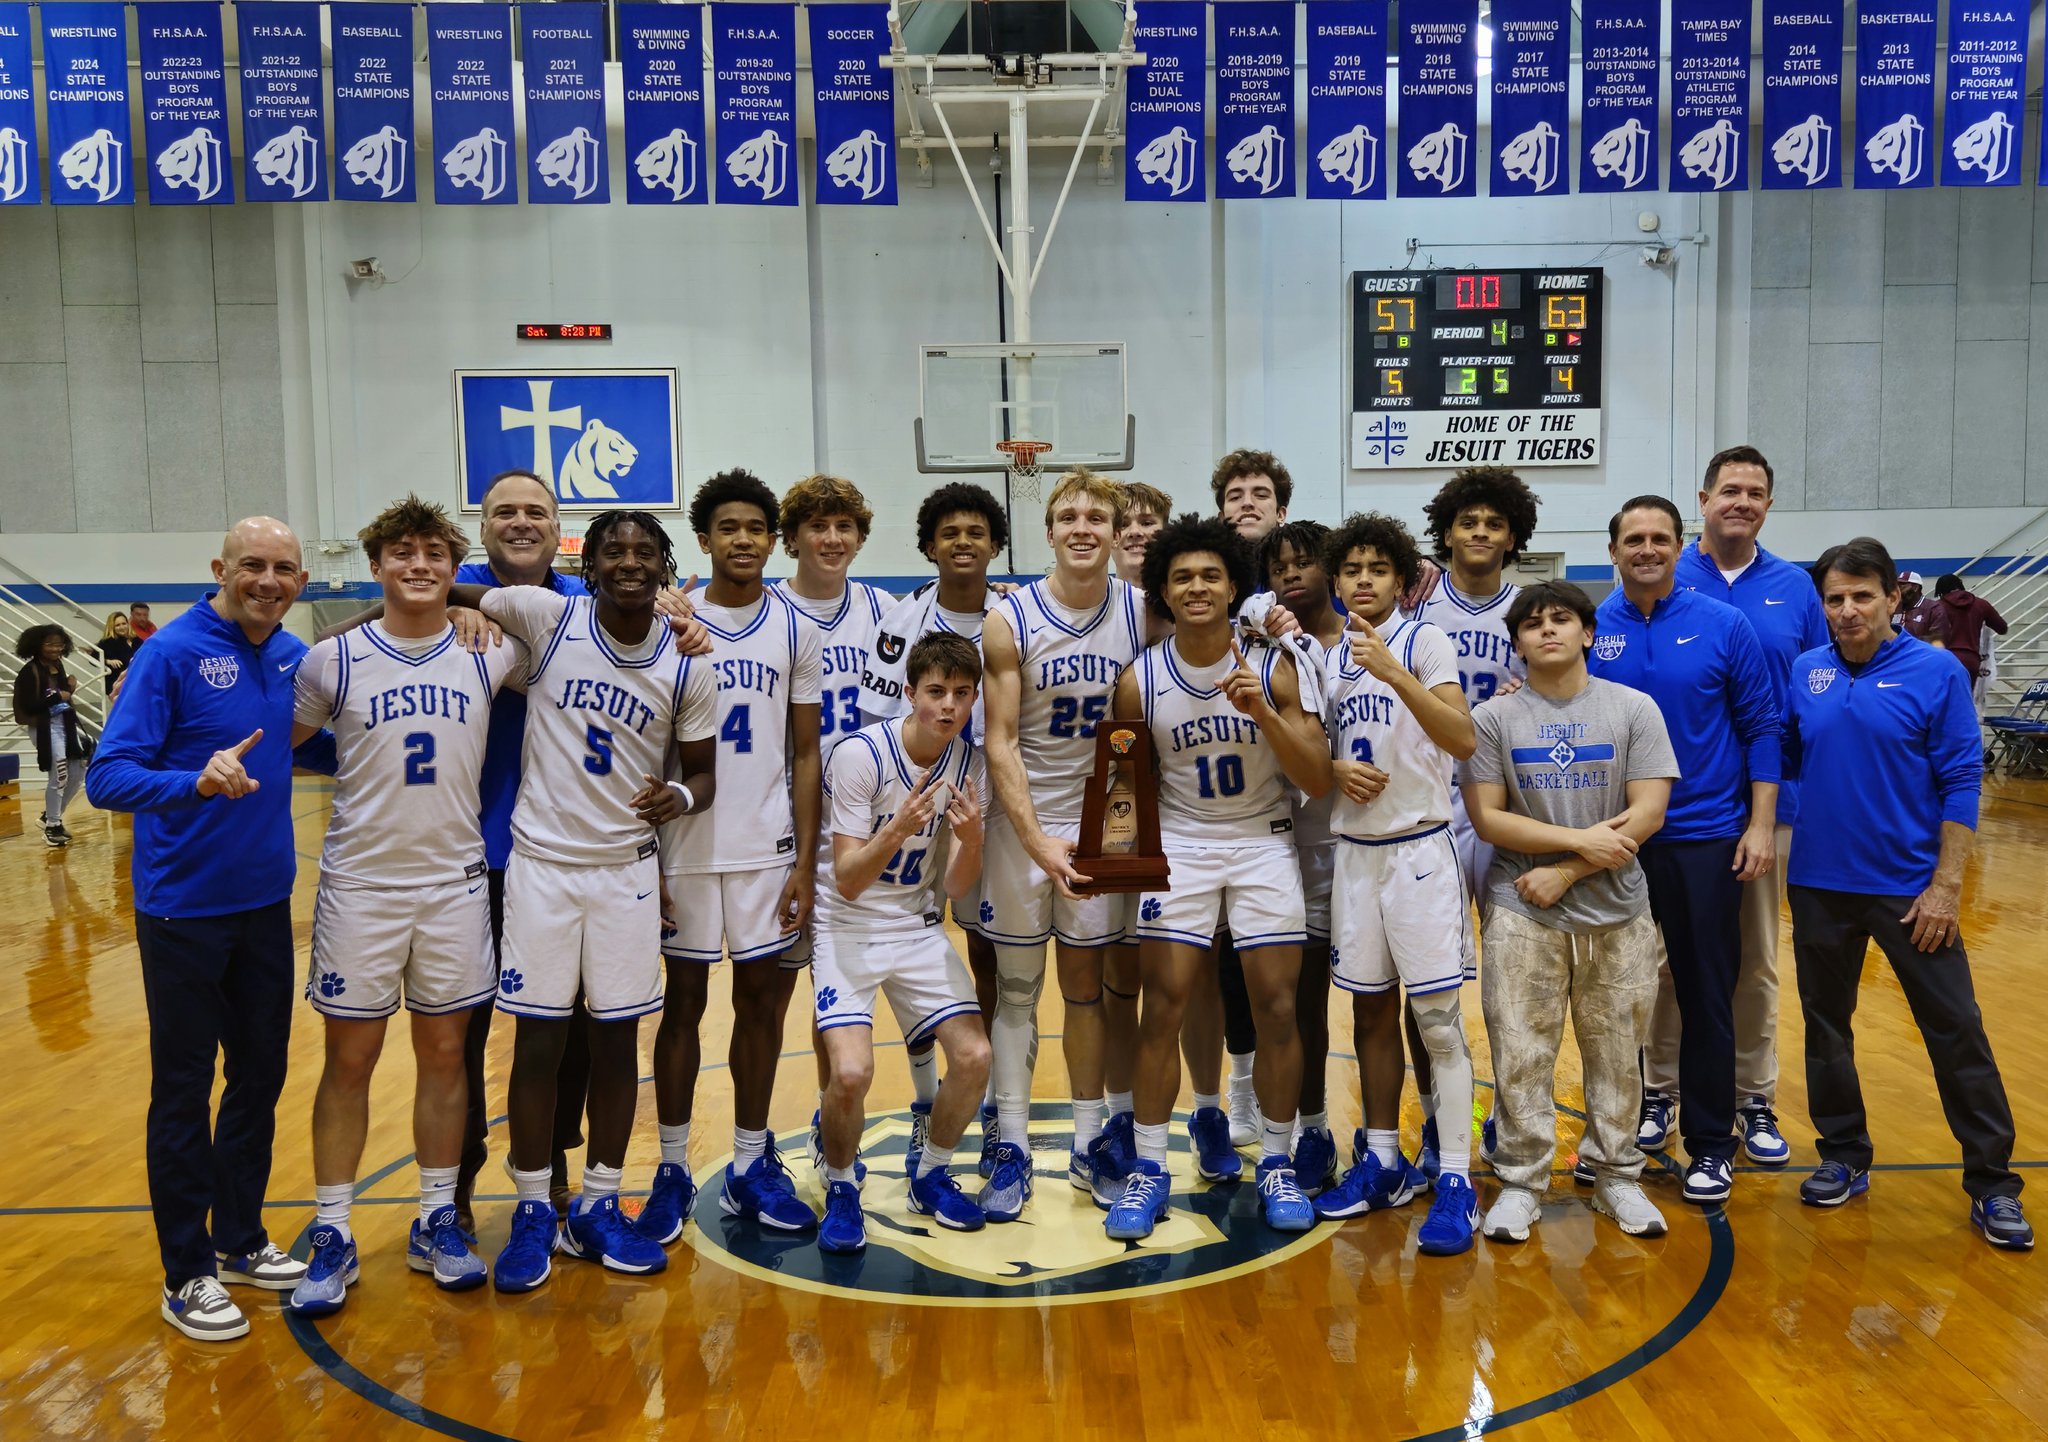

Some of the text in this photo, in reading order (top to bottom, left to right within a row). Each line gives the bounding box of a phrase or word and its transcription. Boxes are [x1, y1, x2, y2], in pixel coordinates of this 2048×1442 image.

[1774, 14, 1832, 25] BASEBALL
[1861, 13, 1934, 24] BASKETBALL
[1963, 12, 2015, 22] F.H.S.A.A.
[1411, 24, 1466, 34] SWIMMING
[1503, 21, 1559, 31] SWIMMING
[1596, 19, 1646, 29] F.H.S.A.A.
[1681, 20, 1742, 30] TAMPA BAY
[50, 27, 117, 38] WRESTLING
[153, 28, 207, 38] F.H.S.A.A.
[253, 27, 306, 36] F.H.S.A.A.
[343, 27, 402, 37] BASEBALL
[436, 30, 502, 39] WRESTLING
[533, 29, 592, 39] FOOTBALL
[633, 29, 690, 39] SWIMMING
[728, 29, 780, 39] F.H.S.A.A.
[828, 30, 874, 40] SOCCER
[1134, 27, 1198, 37] WRESTLING
[1230, 26, 1282, 36] F.H.S.A.A.
[1318, 26, 1376, 35] BASEBALL
[1415, 34, 1462, 44] & DIVING
[1507, 31, 1554, 42] & DIVING
[1695, 32, 1727, 42] TIMES
[638, 39, 685, 50] & DIVING
[1883, 44, 1909, 54] 2013
[1959, 40, 2017, 51] 2011-2012
[1593, 47, 1648, 58] 2013-2014
[1789, 45, 1816, 55] 2014
[163, 57, 202, 66] 2022-23
[262, 56, 300, 65] 2021-22
[1152, 57, 1178, 67] 2020
[1228, 54, 1282, 65] 2018-2019
[1334, 55, 1360, 66] 2019
[1425, 54, 1451, 65] 2018
[1517, 52, 1543, 63] 2017
[1683, 57, 1739, 68] 2013-2014
[1951, 53, 2023, 63] OUTSTANDING
[71, 59, 99, 70] 2024
[360, 58, 386, 68] 2022
[457, 60, 484, 71] 2022
[550, 60, 576, 70] 2021
[649, 60, 676, 71] 2020
[736, 58, 773, 68] 2019-20
[839, 60, 865, 70] 2020
[1586, 60, 1656, 70] OUTSTANDING
[1784, 59, 1821, 71] STATE
[1877, 59, 1914, 70] STATE
[144, 70, 221, 80] OUTSTANDING
[244, 69, 318, 78] OUTSTANDING
[718, 71, 791, 81] OUTSTANDING
[1220, 67, 1290, 77] OUTSTANDING
[1329, 70, 1366, 80] STATE
[1420, 69, 1456, 79] STATE
[1512, 67, 1549, 78] STATE
[1675, 70, 1746, 80] OUTSTANDING
[1972, 66, 2001, 76] BOYS
[67, 74, 106, 85] STATE
[354, 72, 392, 83] STATE
[452, 75, 491, 85] STATE
[545, 74, 583, 85] STATE
[644, 75, 682, 85] STATE
[834, 75, 871, 85] STATE
[1147, 72, 1184, 82] STATE
[1607, 73, 1634, 82] BOYS
[1767, 74, 1838, 86] CHAMPIONS
[1860, 74, 1930, 86] CHAMPIONS
[268, 83, 297, 92] BOYS
[1242, 80, 1269, 89] BOYS
[1495, 81, 1565, 94] CHAMPIONS
[1687, 83, 1735, 92] ATHLETIC
[1960, 78, 2013, 88] PROGRAM
[169, 84, 199, 93] BOYS
[337, 87, 410, 99] CHAMPIONS
[741, 85, 770, 94] BOYS
[1150, 87, 1182, 96] DUAL
[1311, 85, 1383, 96] CHAMPIONS
[1403, 84, 1473, 95] CHAMPIONS
[1596, 85, 1645, 95] PROGRAM
[49, 90, 124, 101] CHAMPIONS
[435, 90, 509, 101] CHAMPIONS
[529, 89, 601, 100] CHAMPIONS
[627, 90, 699, 101] CHAMPIONS
[818, 90, 889, 101] CHAMPIONS
[1230, 92, 1280, 101] PROGRAM
[1685, 94, 1736, 104] PROGRAM
[1951, 90, 2018, 100] OF THE YEAR
[157, 97, 213, 107] PROGRAM
[256, 96, 309, 105] PROGRAM
[729, 98, 782, 107] PROGRAM
[1588, 97, 1652, 107] OF THE YEAR
[1130, 102, 1201, 112] CHAMPIONS
[1224, 103, 1286, 114] OF THE YEAR
[1677, 106, 1742, 117] OF THE YEAR
[150, 110, 220, 120] OF THE YEAR
[249, 109, 318, 118] OF THE YEAR
[722, 111, 789, 121] OF THE YEAR
[1365, 278, 1420, 292] GUEST
[1538, 275, 1588, 289] HOME
[1456, 276, 1500, 308] 0.0
[1376, 299, 1414, 331] 57
[1548, 296, 1586, 328] 63
[526, 326, 602, 336] Sat. 8:28 PM
[1433, 327, 1483, 339] PERIOD
[1492, 321, 1506, 344] 4
[1400, 336, 1409, 347] B
[1546, 334, 1556, 344] B
[1376, 358, 1409, 367] FOULS
[1442, 356, 1514, 366] PLAYER-FOUL
[1546, 355, 1579, 365] FOULS
[1388, 370, 1402, 394] 5
[1461, 368, 1476, 394] 2
[1493, 369, 1508, 393] 5
[1558, 368, 1573, 391] 4
[1374, 397, 1411, 406] POINTS
[1442, 396, 1480, 405] MATCH
[1544, 394, 1581, 404] POINTS
[1446, 415, 1576, 433] HOME OF THE
[1425, 438, 1596, 462] JESUIT TIGERS
[199, 656, 236, 669] JESUIT
[1036, 654, 1122, 691] JESUIT
[365, 684, 470, 730] JESUIT
[556, 679, 655, 736] JESUIT
[1050, 696, 1108, 738] 25
[720, 703, 753, 754] 4
[1172, 715, 1260, 752] JESUIT
[1537, 724, 1587, 739] JESUIT
[584, 722, 613, 777] 5
[404, 731, 437, 786] 2
[1195, 754, 1245, 799] 10
[1516, 771, 1608, 790] BASKETBALL
